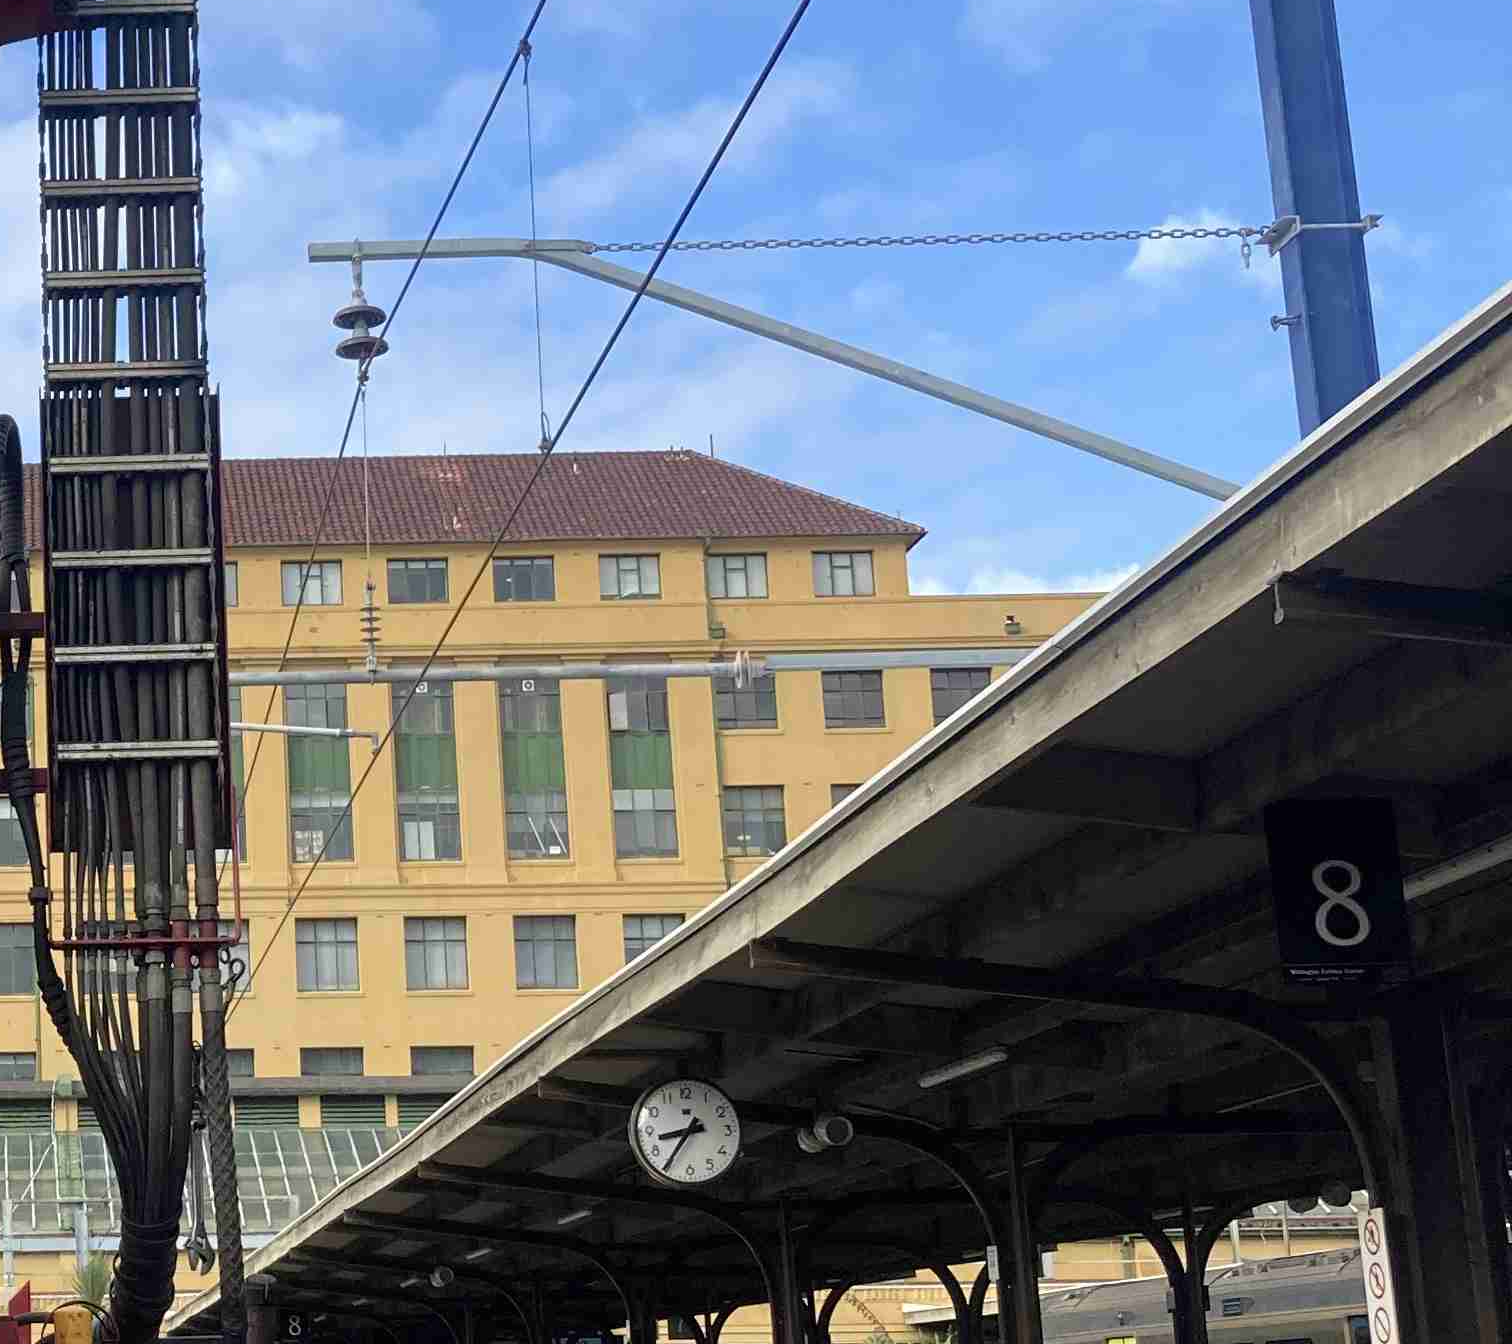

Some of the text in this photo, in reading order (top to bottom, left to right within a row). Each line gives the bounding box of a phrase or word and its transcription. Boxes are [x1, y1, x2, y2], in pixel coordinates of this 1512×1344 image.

[1311, 859, 1370, 946] 8
[679, 1087, 692, 1100] 12
[648, 1106, 659, 1118] 10
[715, 1106, 727, 1118] 2
[645, 1125, 654, 1137] 9
[723, 1125, 732, 1137] 3
[651, 1145, 660, 1156] 8
[717, 1145, 727, 1155] 4
[686, 1164, 695, 1176] 6
[706, 1159, 714, 1170] 5
[288, 1315, 302, 1336] 8
